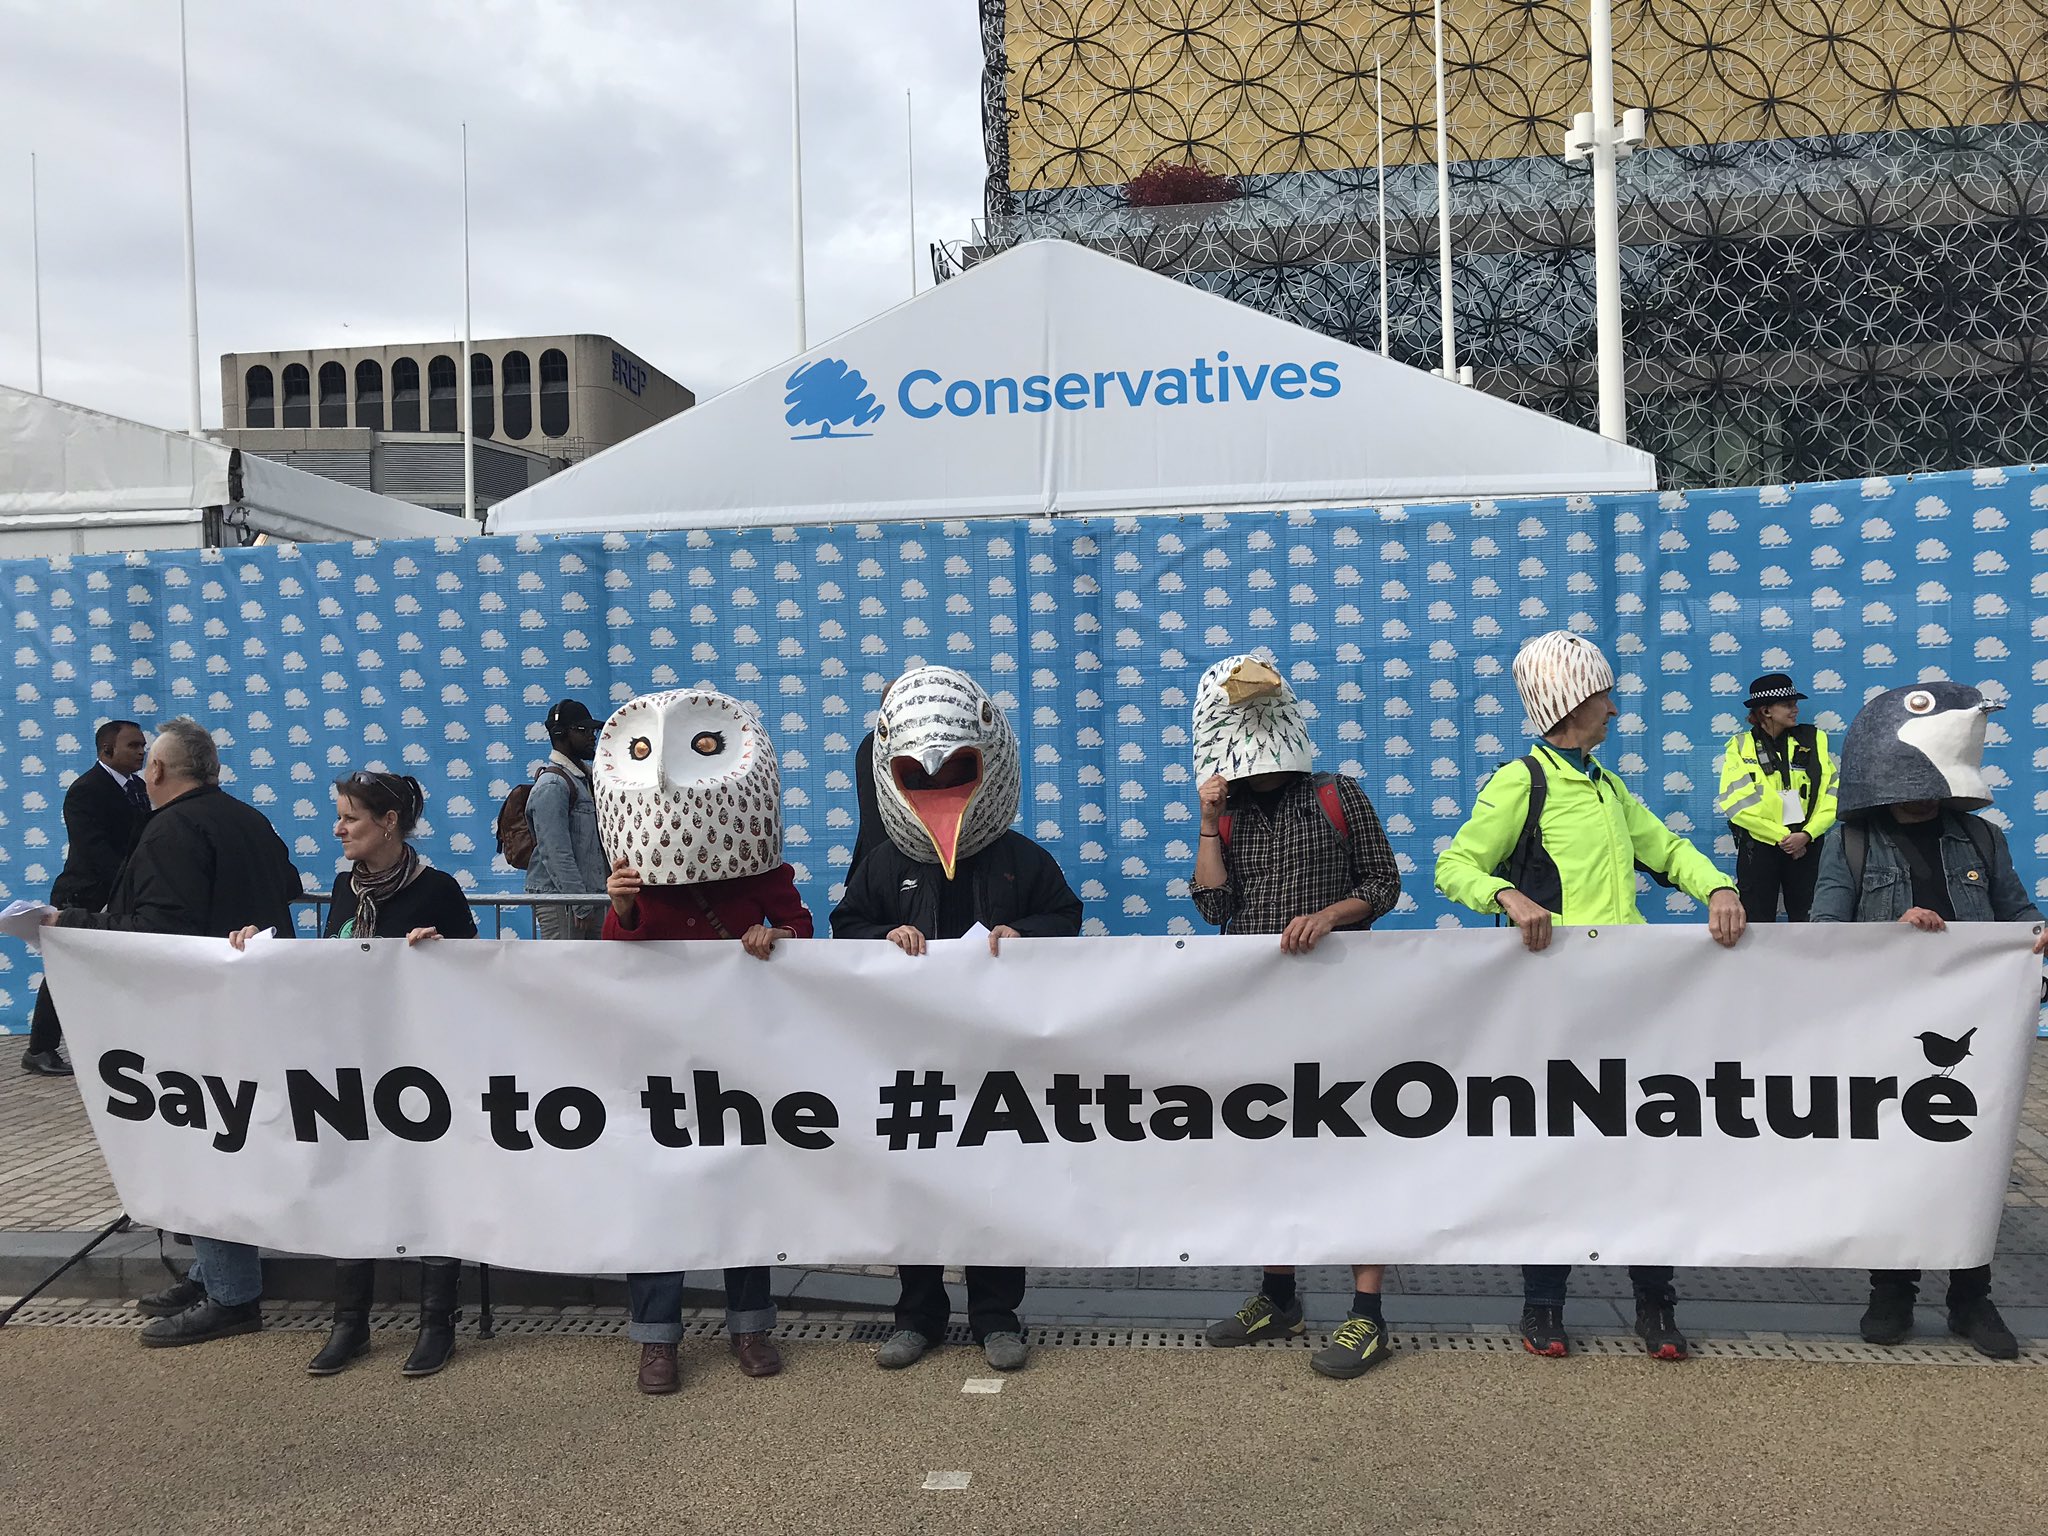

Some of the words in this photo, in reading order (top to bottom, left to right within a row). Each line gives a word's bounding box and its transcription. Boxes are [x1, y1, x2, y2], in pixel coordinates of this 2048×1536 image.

[619, 353, 647, 397] REP
[897, 350, 1342, 419] Conservatives
[98, 1049, 258, 1153] Say
[285, 1066, 452, 1143] NO
[481, 1075, 607, 1151] to
[640, 1069, 840, 1150] the
[876, 1058, 1978, 1151] #AttackOnNature
